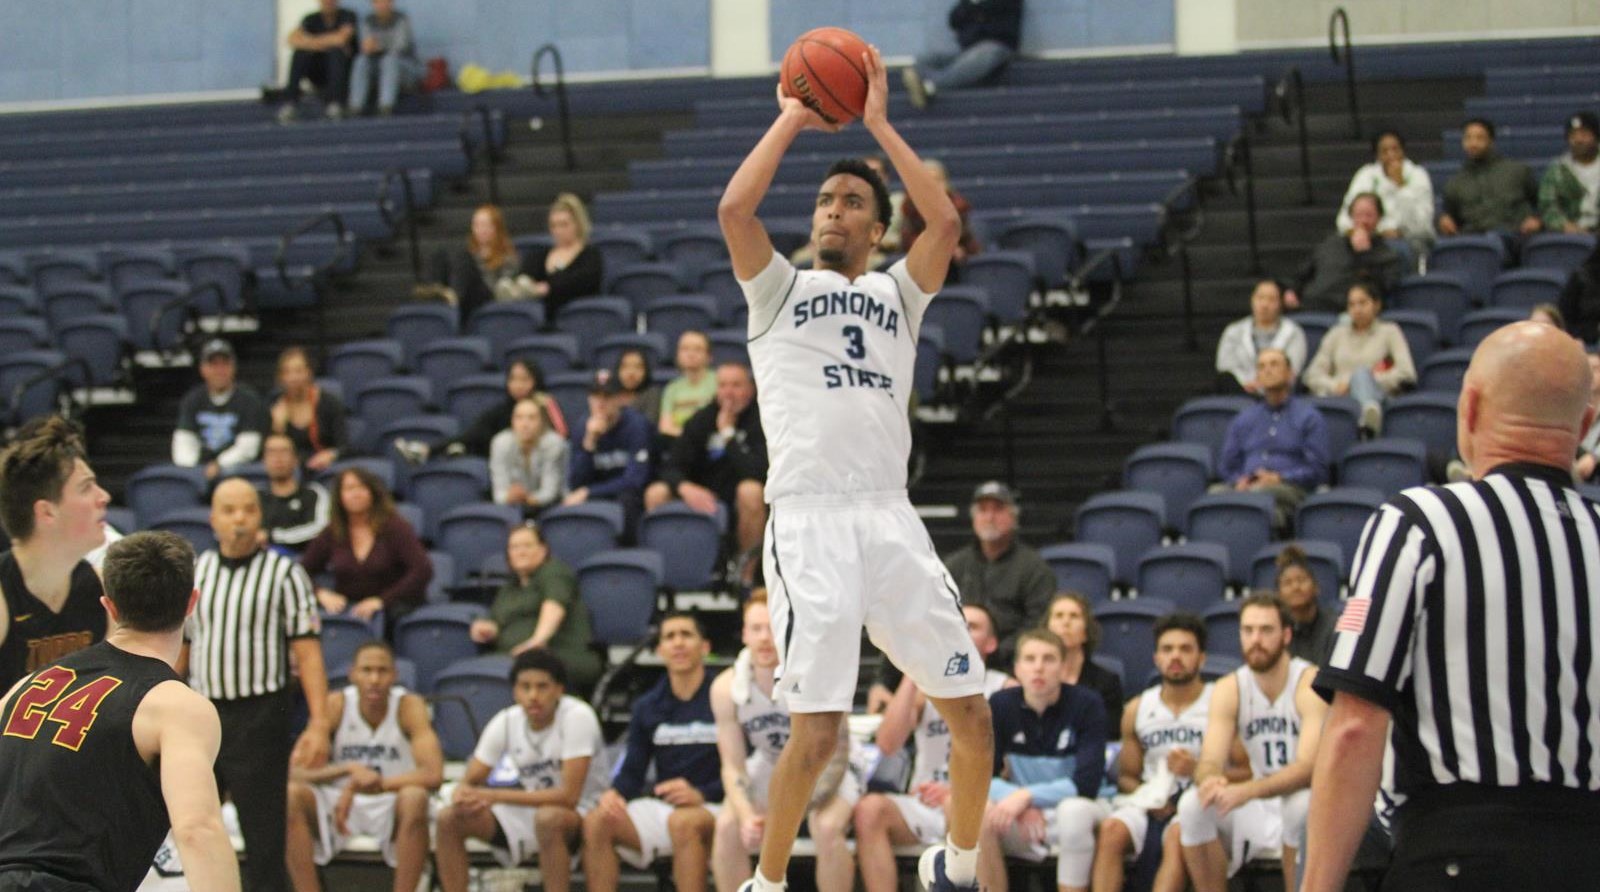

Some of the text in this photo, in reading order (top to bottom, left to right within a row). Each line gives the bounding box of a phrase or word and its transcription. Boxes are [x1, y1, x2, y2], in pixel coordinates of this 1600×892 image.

[794, 290, 898, 338] SONOMA
[842, 325, 866, 360] 3
[3, 665, 123, 752] 24
[1143, 726, 1204, 750] SONOM
[1263, 740, 1287, 767] 13
